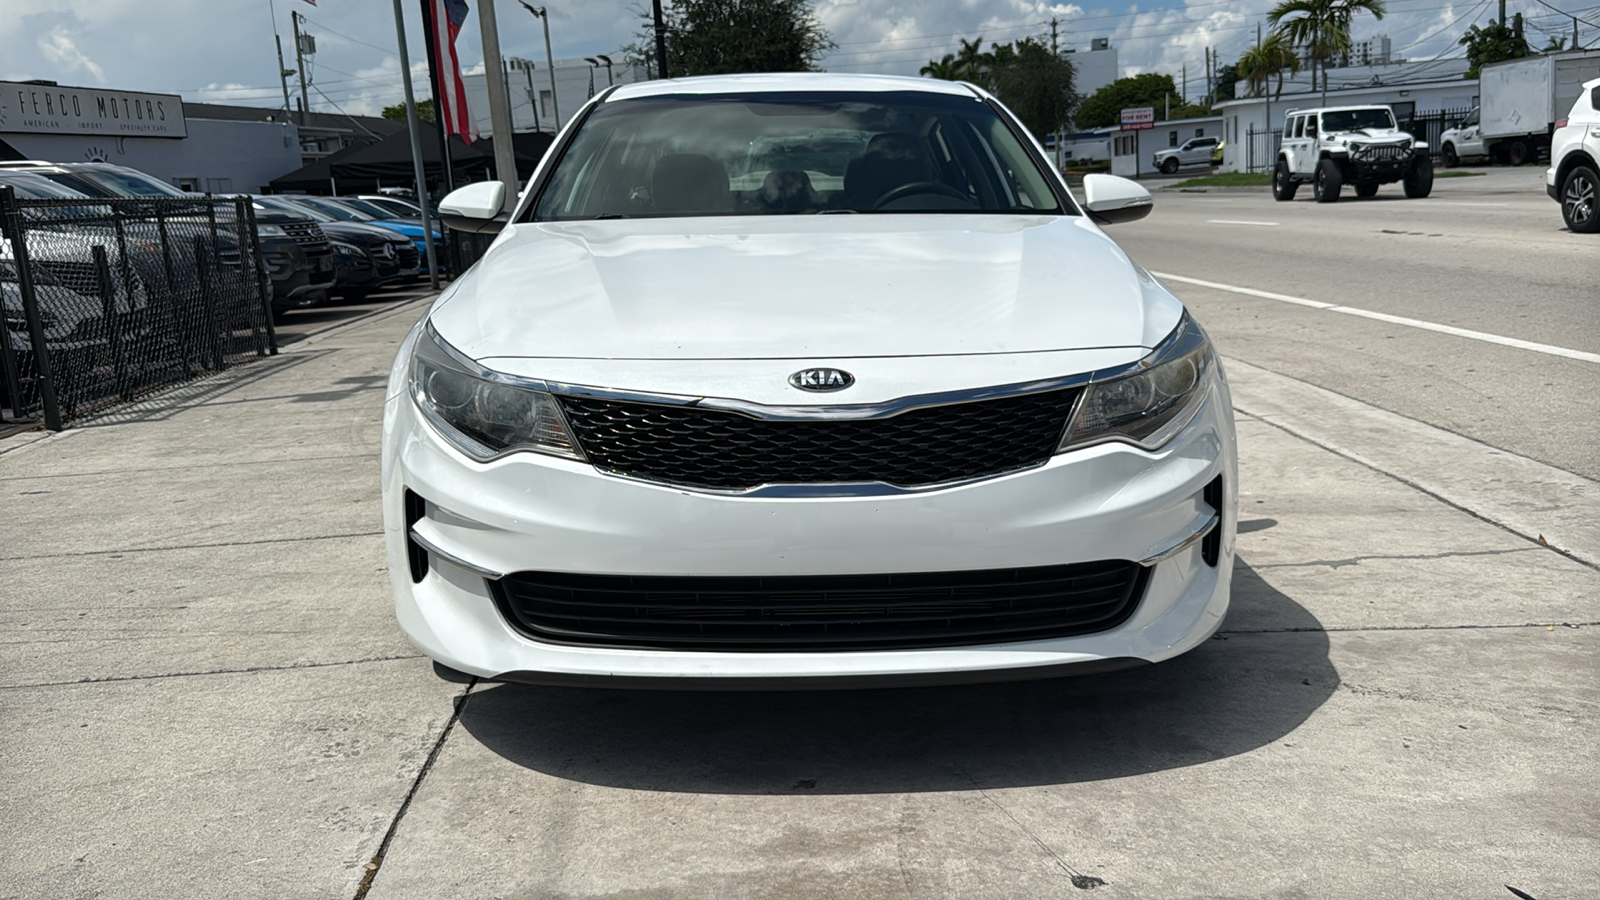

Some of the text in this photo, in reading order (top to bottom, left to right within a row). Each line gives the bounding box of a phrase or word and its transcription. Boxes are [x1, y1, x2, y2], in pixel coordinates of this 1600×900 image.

[18, 91, 166, 122] FERCO MOTORS
[23, 120, 60, 128] AMERICAN
[800, 370, 845, 386] KIA
